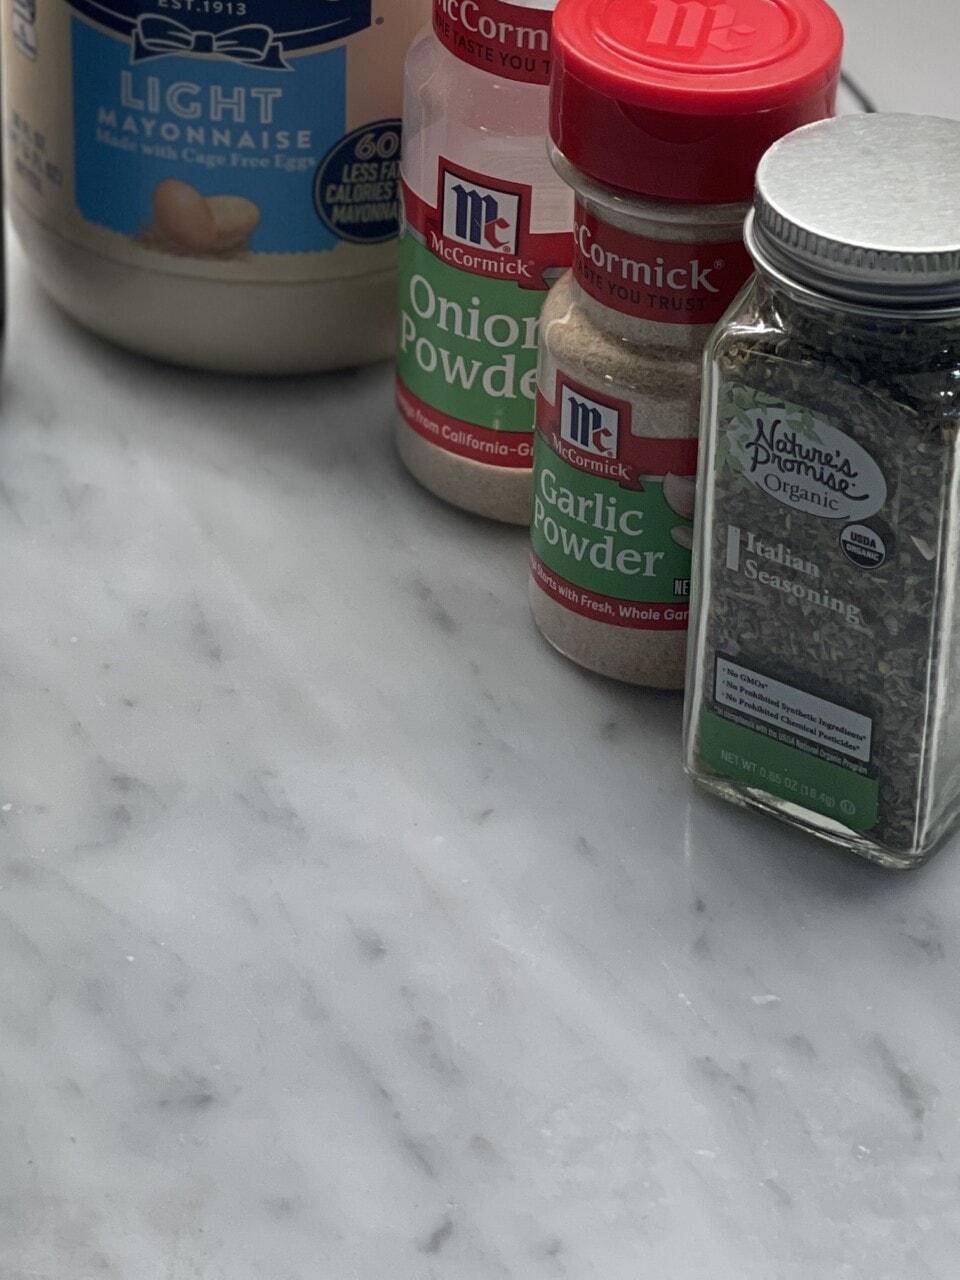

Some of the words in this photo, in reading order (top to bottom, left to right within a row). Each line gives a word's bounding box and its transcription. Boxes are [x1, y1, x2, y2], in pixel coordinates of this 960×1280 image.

[453, 31, 495, 63] TASTE
[499, 51, 536, 72] YOU
[120, 69, 283, 125] LIGHT
[97, 106, 312, 149] MAYONNAISE
[95, 127, 138, 151] Made
[141, 142, 178, 161] with
[181, 147, 227, 169] Cage
[231, 152, 271, 169] Free
[274, 153, 316, 173] Eggs
[326, 181, 394, 205] CALORIES
[341, 162, 379, 183] LESS
[430, 230, 533, 278] McCormick
[608, 281, 642, 306] YOU
[647, 293, 708, 312] TRUST
[415, 409, 440, 434] from
[551, 432, 631, 480] McCormick
[754, 417, 859, 478] Nature's
[744, 441, 870, 501] Promise
[763, 472, 840, 512] Organic
[539, 467, 645, 537] Garlic
[534, 492, 666, 578] Powder
[744, 531, 820, 579] Italian
[845, 543, 880, 562] ORGANIC
[850, 531, 877, 549] USDA
[558, 584, 579, 604] with
[581, 595, 616, 617] Fresh,
[618, 604, 661, 621] Whole
[674, 579, 691, 595] NE
[743, 558, 861, 625] Seasoning
[726, 667, 739, 679] No
[725, 691, 738, 704] No
[738, 696, 779, 721] Prohibited
[780, 714, 817, 738] Chemical
[726, 679, 738, 691] No
[739, 684, 780, 709] Prohibited
[781, 702, 817, 724] Synthetic
[720, 749, 739, 766] NET
[741, 760, 758, 774] WT
[783, 777, 799, 792] OZ
